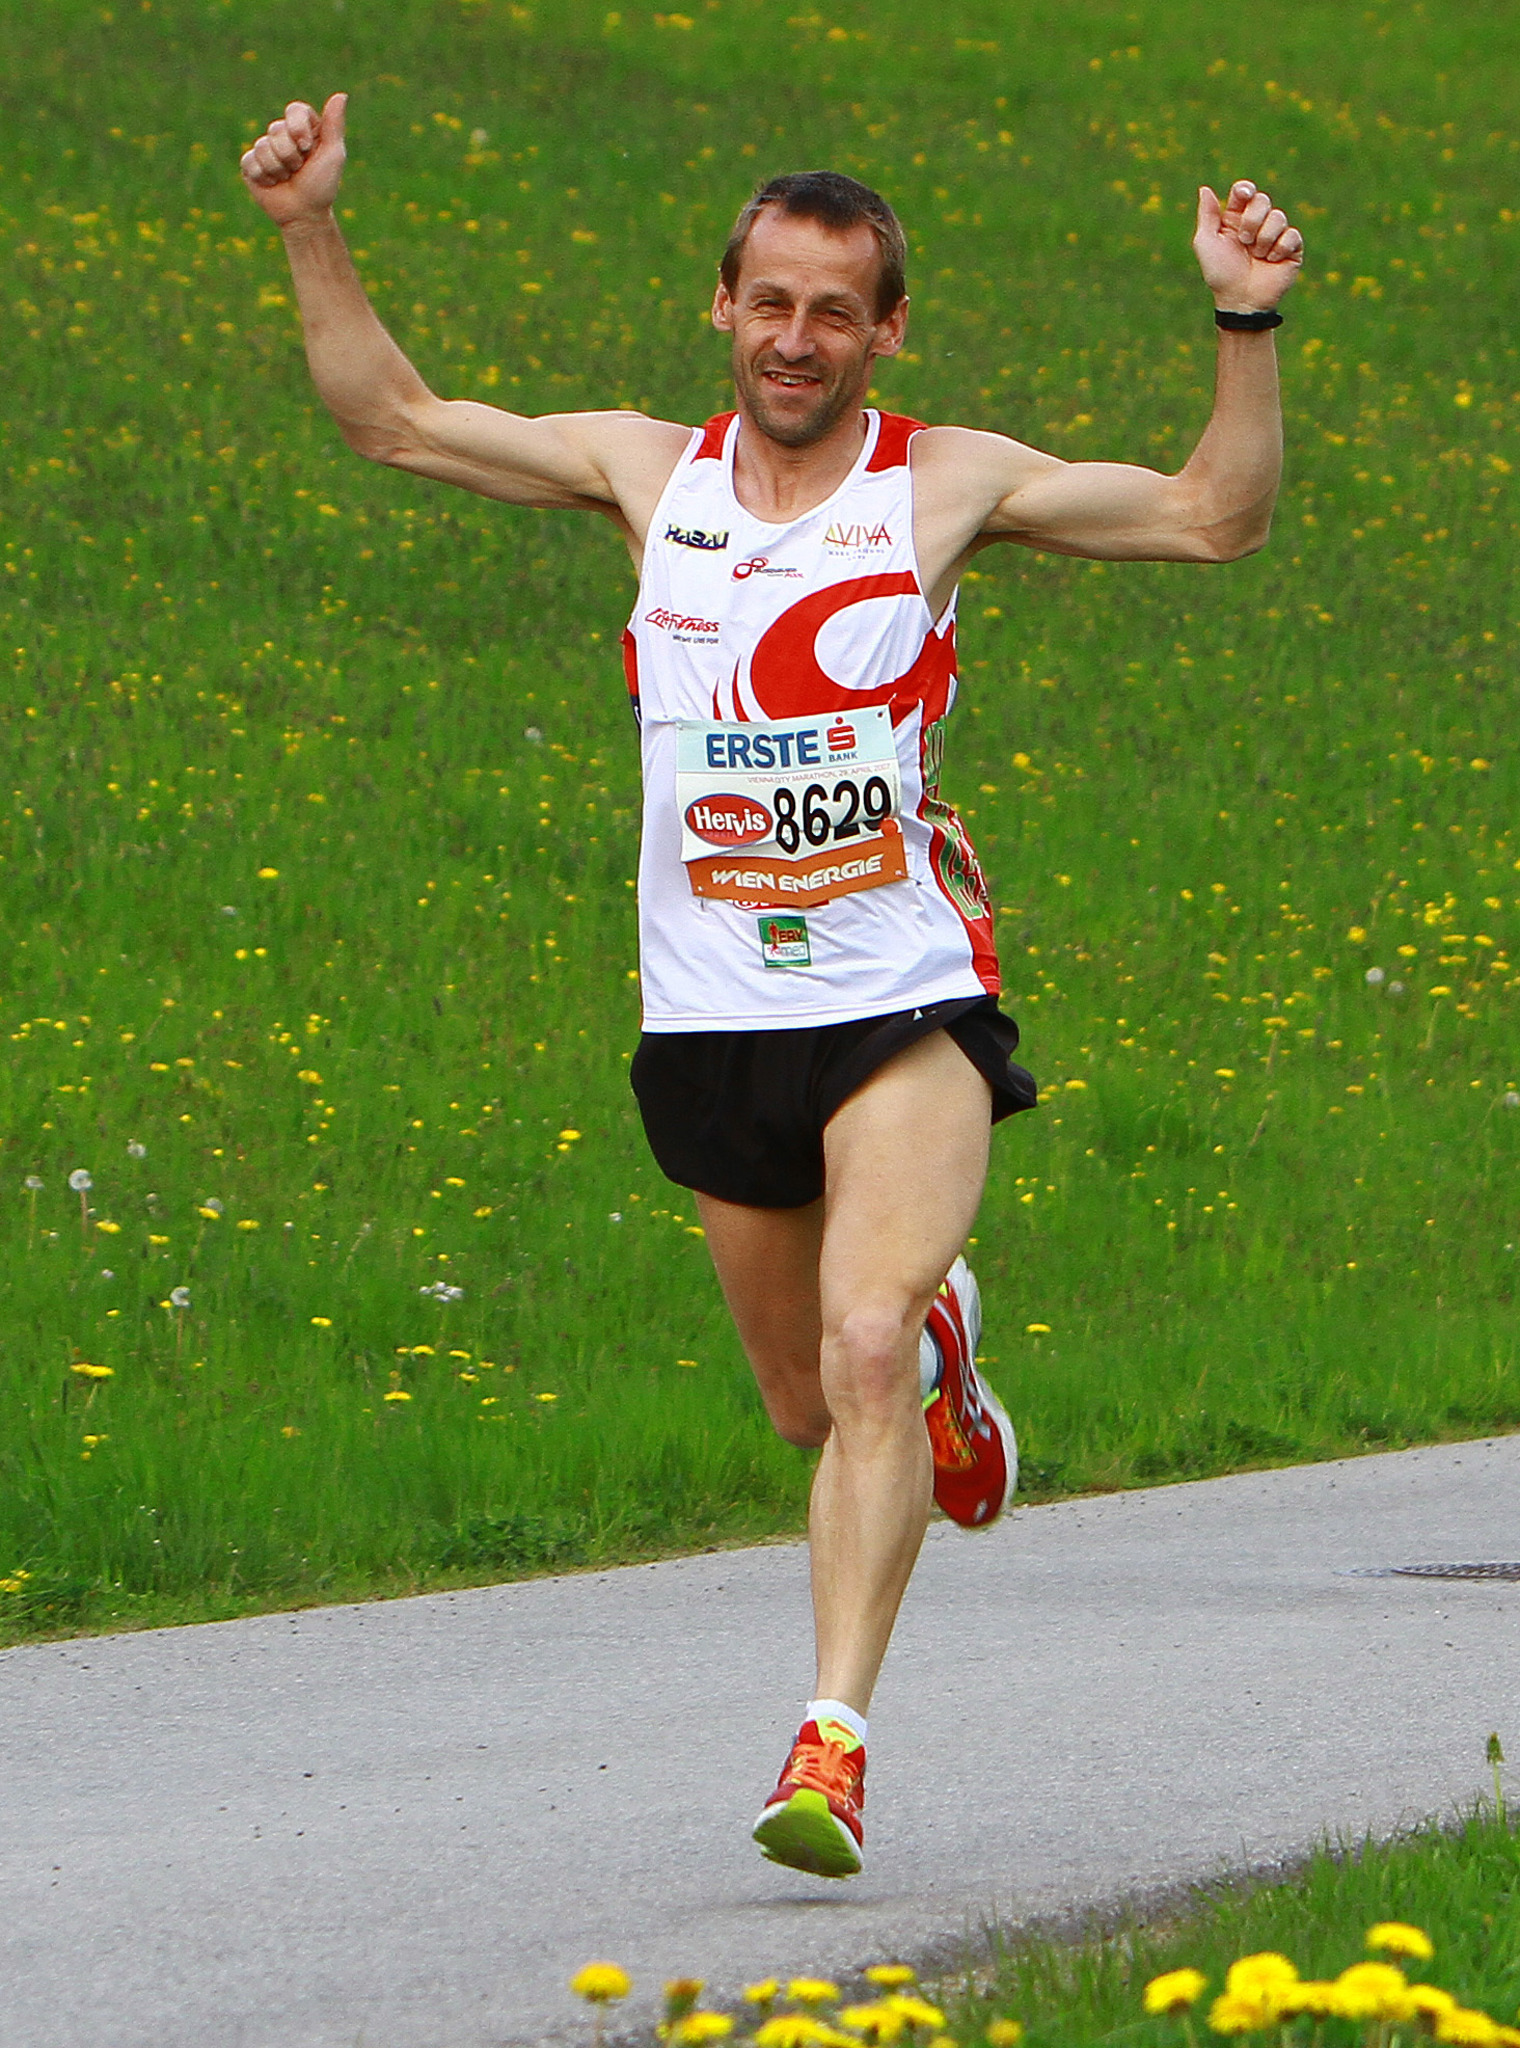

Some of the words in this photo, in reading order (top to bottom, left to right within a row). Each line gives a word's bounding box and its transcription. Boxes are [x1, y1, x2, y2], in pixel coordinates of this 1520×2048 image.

[821, 522, 893, 548] AVIVA
[706, 729, 822, 769] ERSTE
[829, 751, 859, 764] BANK
[692, 806, 768, 837] Hervis
[773, 775, 893, 855] 8629
[711, 869, 776, 890] WIEN
[778, 853, 885, 893] ENERGIE
